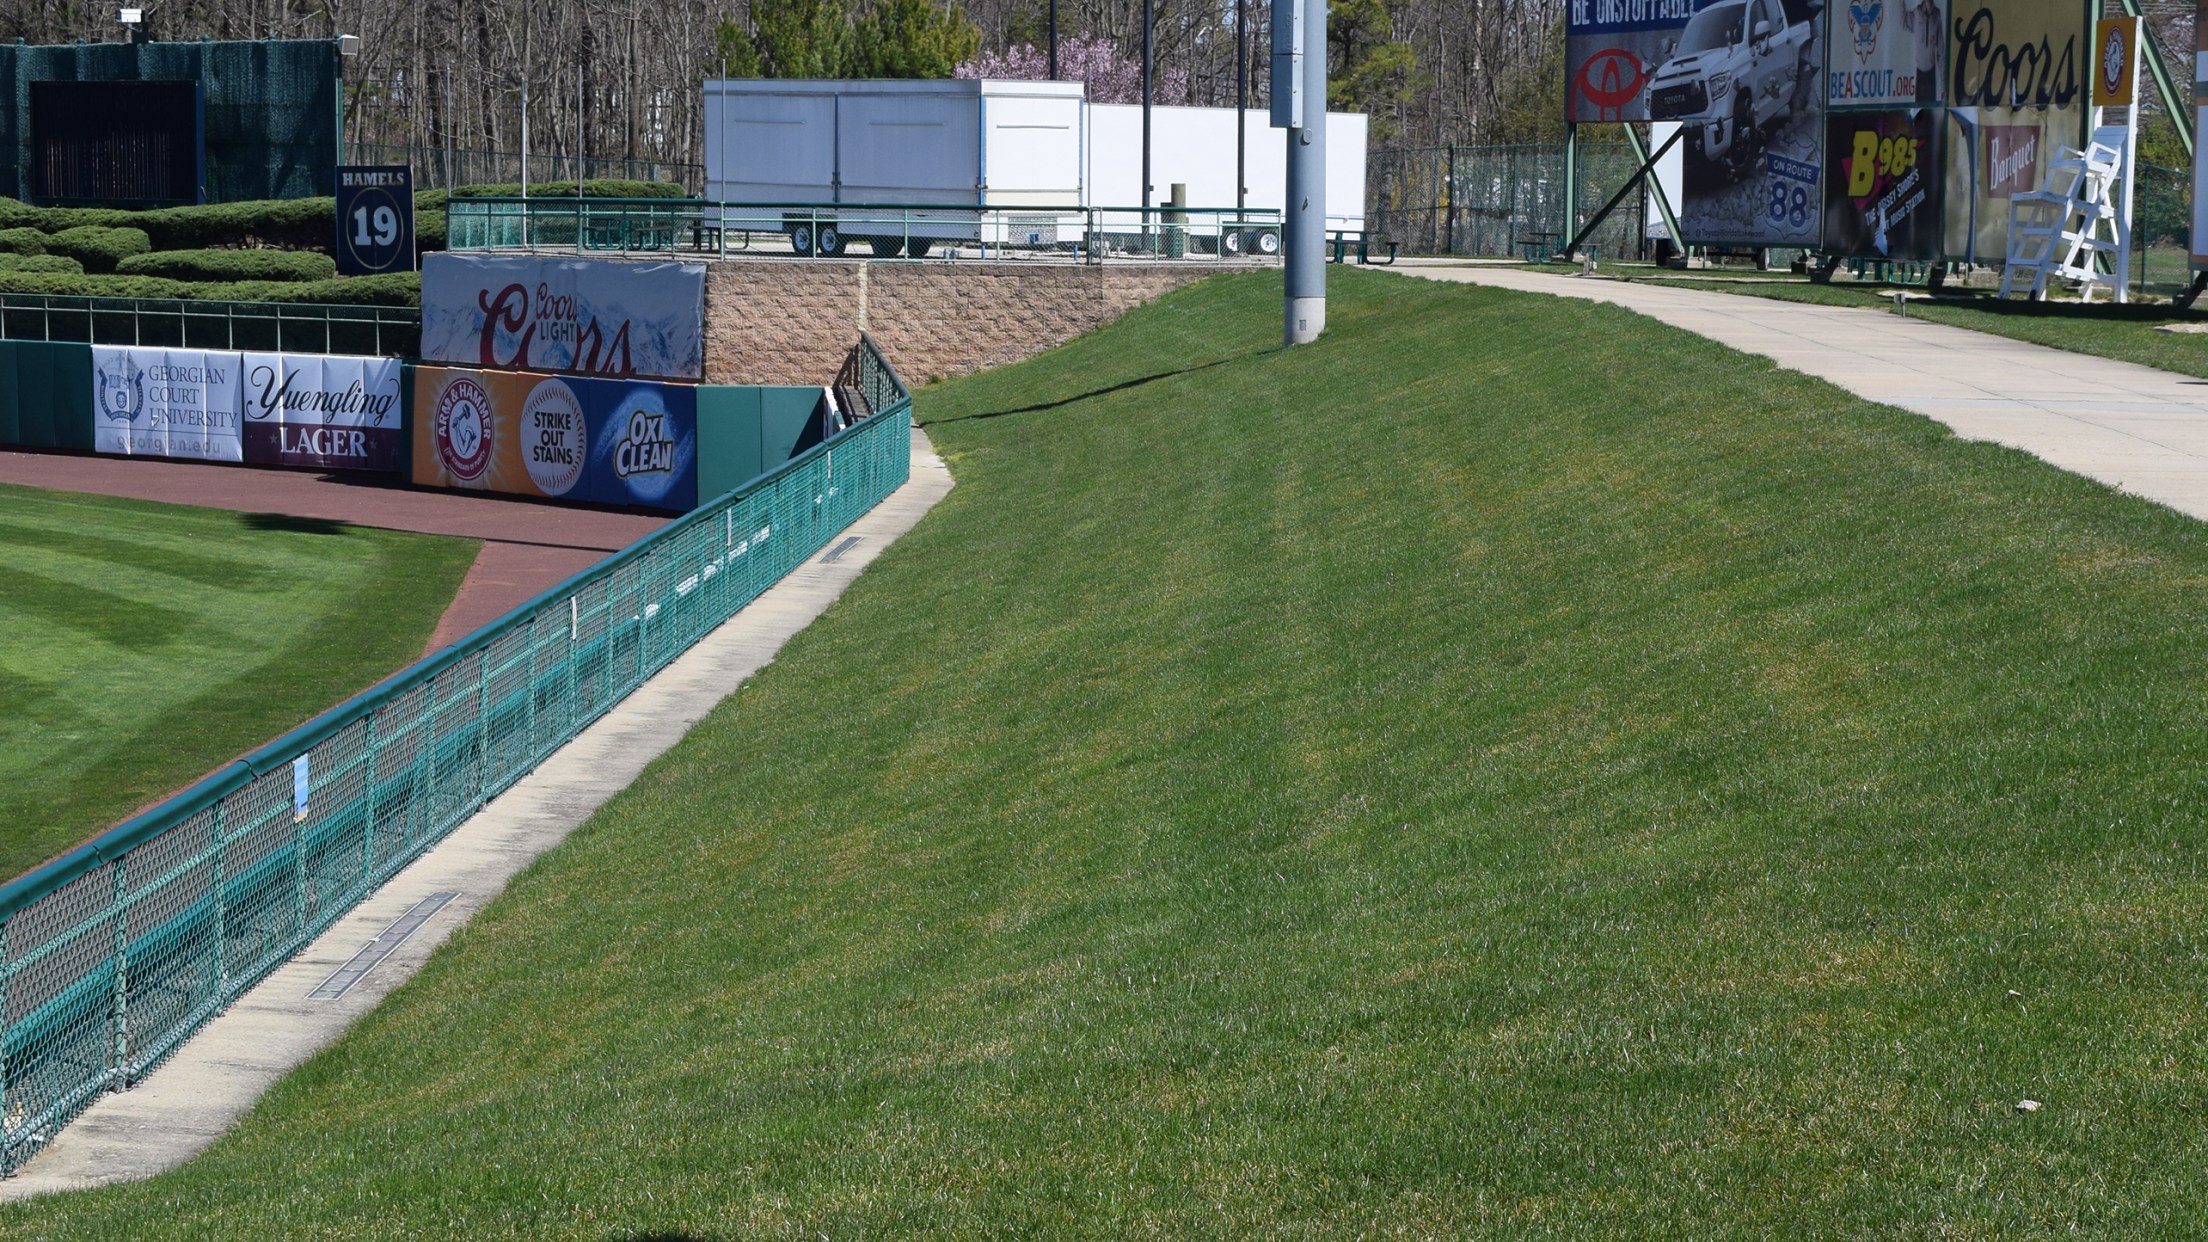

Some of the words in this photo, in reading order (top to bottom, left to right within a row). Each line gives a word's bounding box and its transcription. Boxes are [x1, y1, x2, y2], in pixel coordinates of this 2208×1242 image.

[1572, 0, 1590, 26] BE
[1955, 8, 2079, 112] Coors
[1830, 69, 1915, 99] BEASCOUT.ORG
[1664, 94, 1686, 105] TOYOTA
[1773, 160, 1785, 172] ON
[1786, 163, 1812, 179] ROUTE
[1990, 134, 2036, 190] Banquet
[342, 172, 404, 186] HAMELS
[1770, 181, 1807, 228] 88
[354, 205, 397, 246] 19
[540, 321, 574, 342] LIGHT
[149, 365, 225, 384] GEORGIAN
[149, 386, 199, 404] COURT
[246, 365, 400, 426] Yuengling
[150, 408, 238, 428] UNIVERSITY
[438, 397, 451, 438] ARM
[450, 388, 459, 403] &
[459, 384, 491, 440] HAMMER
[534, 411, 571, 430] STRIKE
[541, 430, 564, 446] OUT
[629, 410, 664, 446] OXI
[117, 436, 221, 454] georgian.edu
[279, 427, 368, 457] LAGER
[533, 446, 573, 465] STAINS
[615, 440, 673, 477] CLEAN
